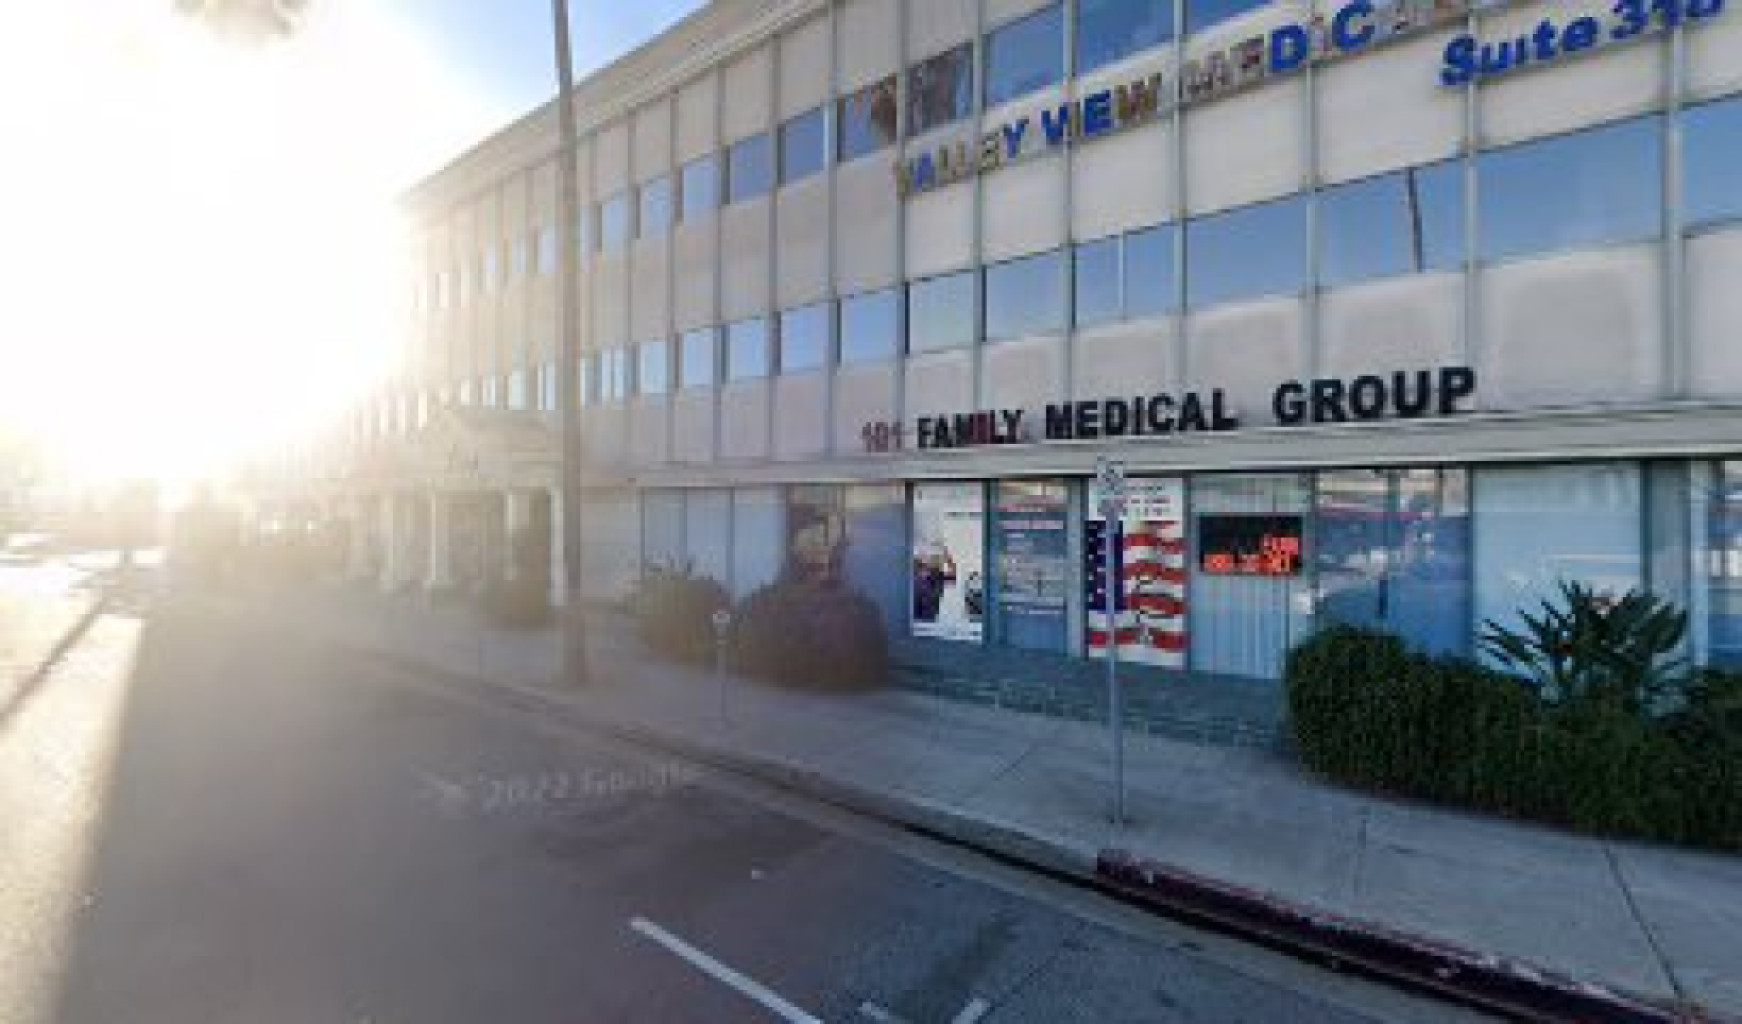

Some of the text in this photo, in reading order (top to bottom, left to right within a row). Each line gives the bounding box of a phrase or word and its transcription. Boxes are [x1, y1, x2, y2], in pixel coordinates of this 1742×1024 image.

[1439, 16, 1598, 86] Suite
[892, 116, 1030, 196] VALLEY
[1040, 72, 1163, 146] VIEW
[916, 409, 1024, 450] FAMILY
[1045, 388, 1239, 441] MEDICAL
[1272, 366, 1475, 425] GROUP
